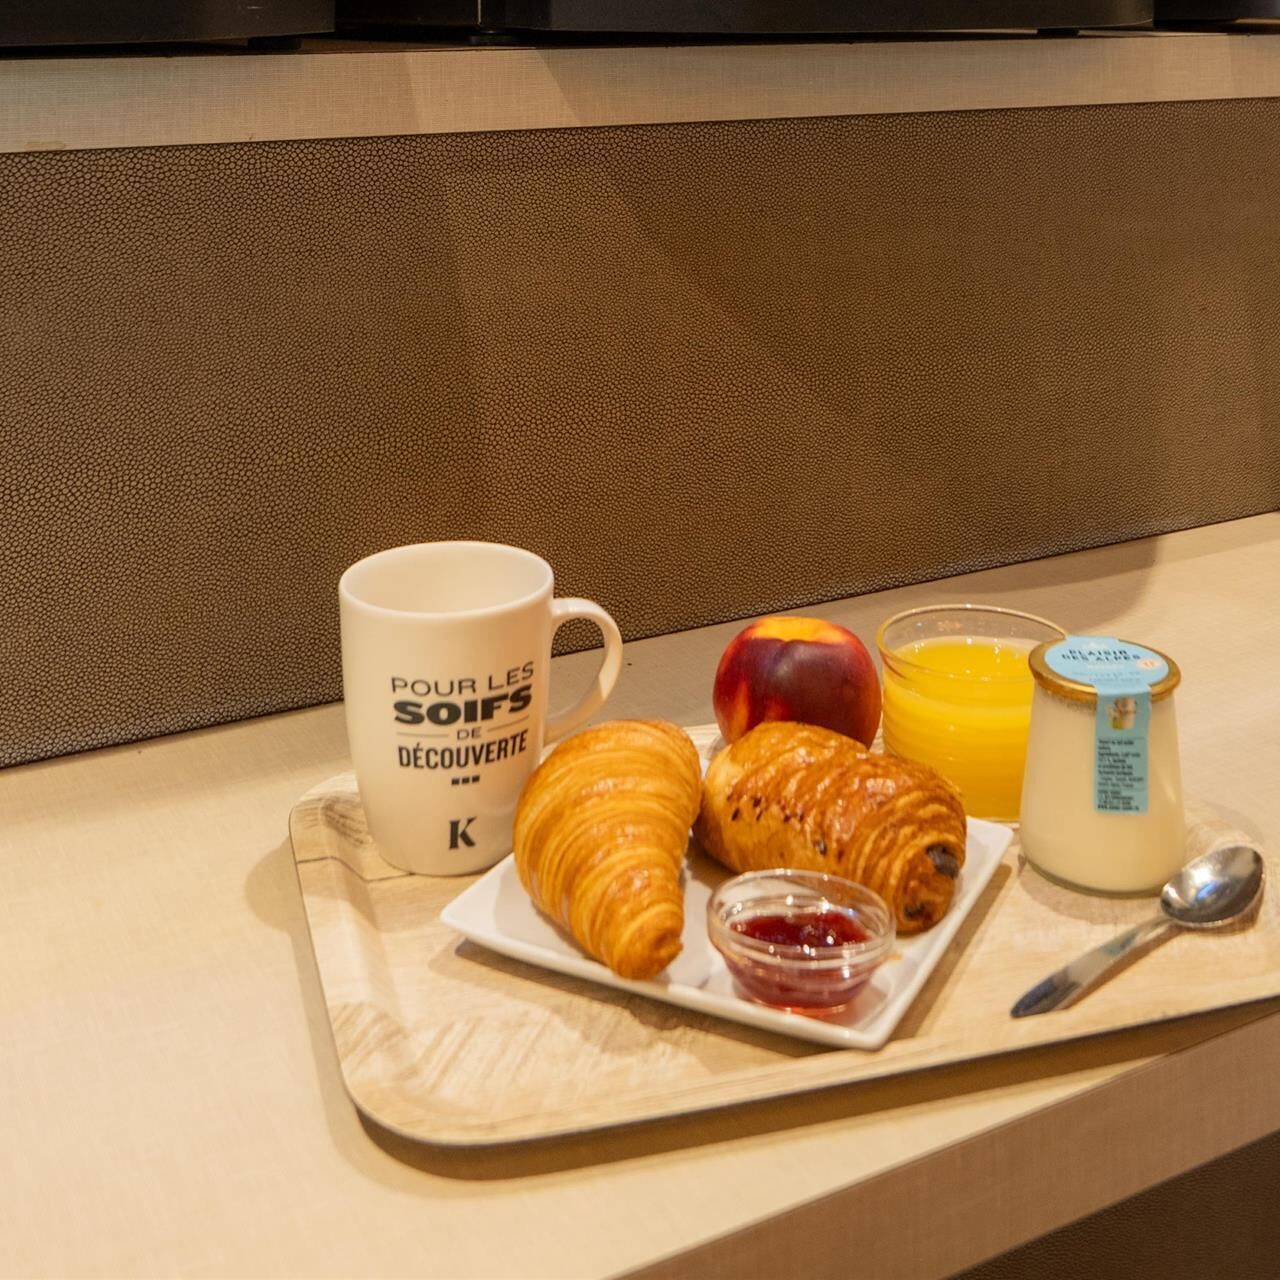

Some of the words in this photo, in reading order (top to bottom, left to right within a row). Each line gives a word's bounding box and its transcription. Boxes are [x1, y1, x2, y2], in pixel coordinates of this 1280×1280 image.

[392, 677, 476, 696] POUR
[488, 661, 534, 690] LES
[393, 685, 532, 725] SOIFS
[398, 729, 528, 770] DÉCOUVERTE
[457, 728, 482, 740] DE
[449, 817, 476, 850] K
